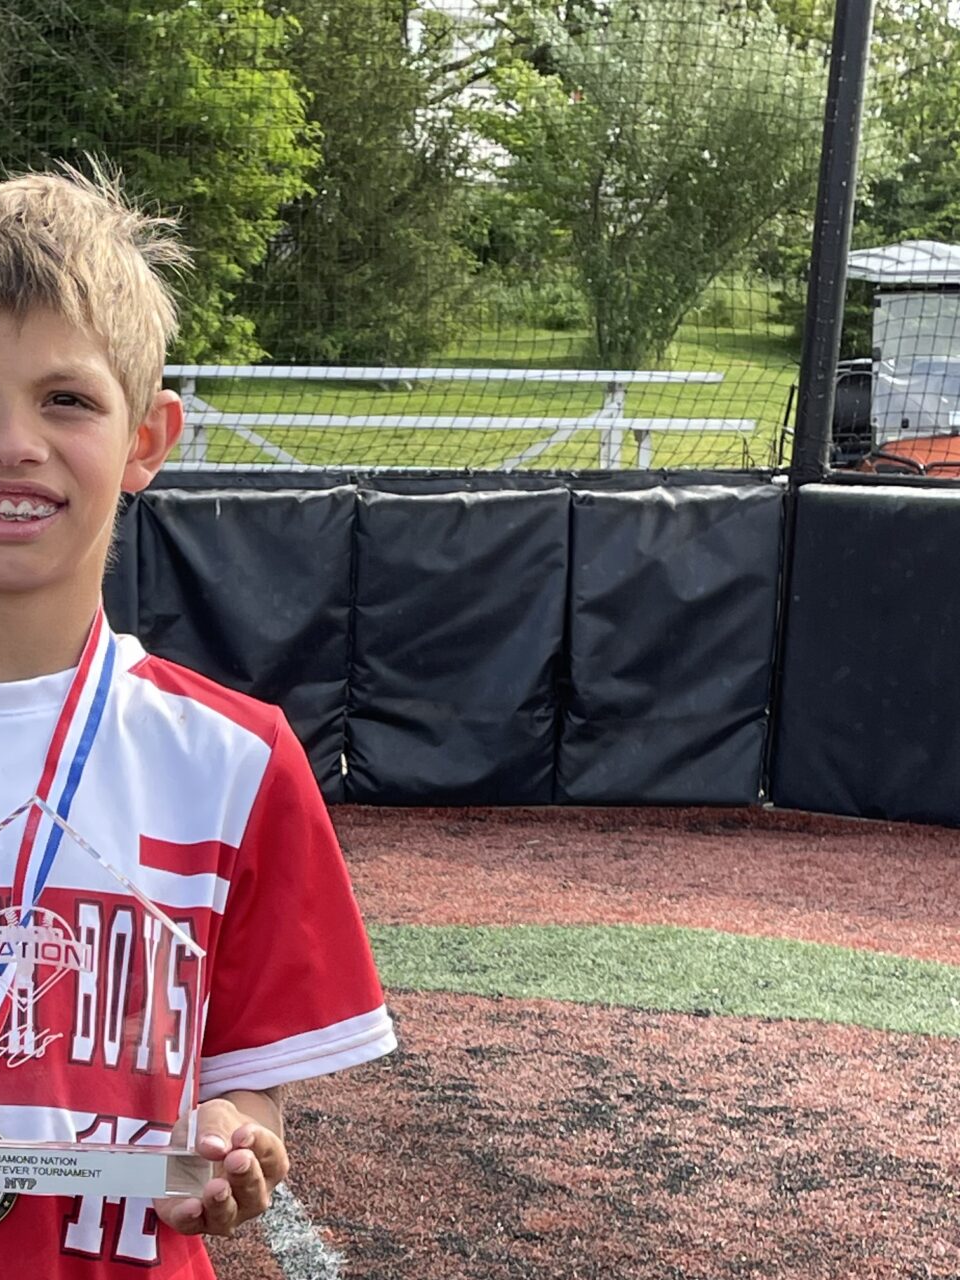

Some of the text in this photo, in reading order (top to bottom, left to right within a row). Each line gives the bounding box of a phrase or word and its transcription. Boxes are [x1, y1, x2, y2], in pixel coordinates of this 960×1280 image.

[71, 902, 193, 1076] BOYS
[41, 1156, 77, 1166] NATION
[32, 1167, 102, 1179] TOURNAMENT
[4, 1177, 37, 1190] MVP
